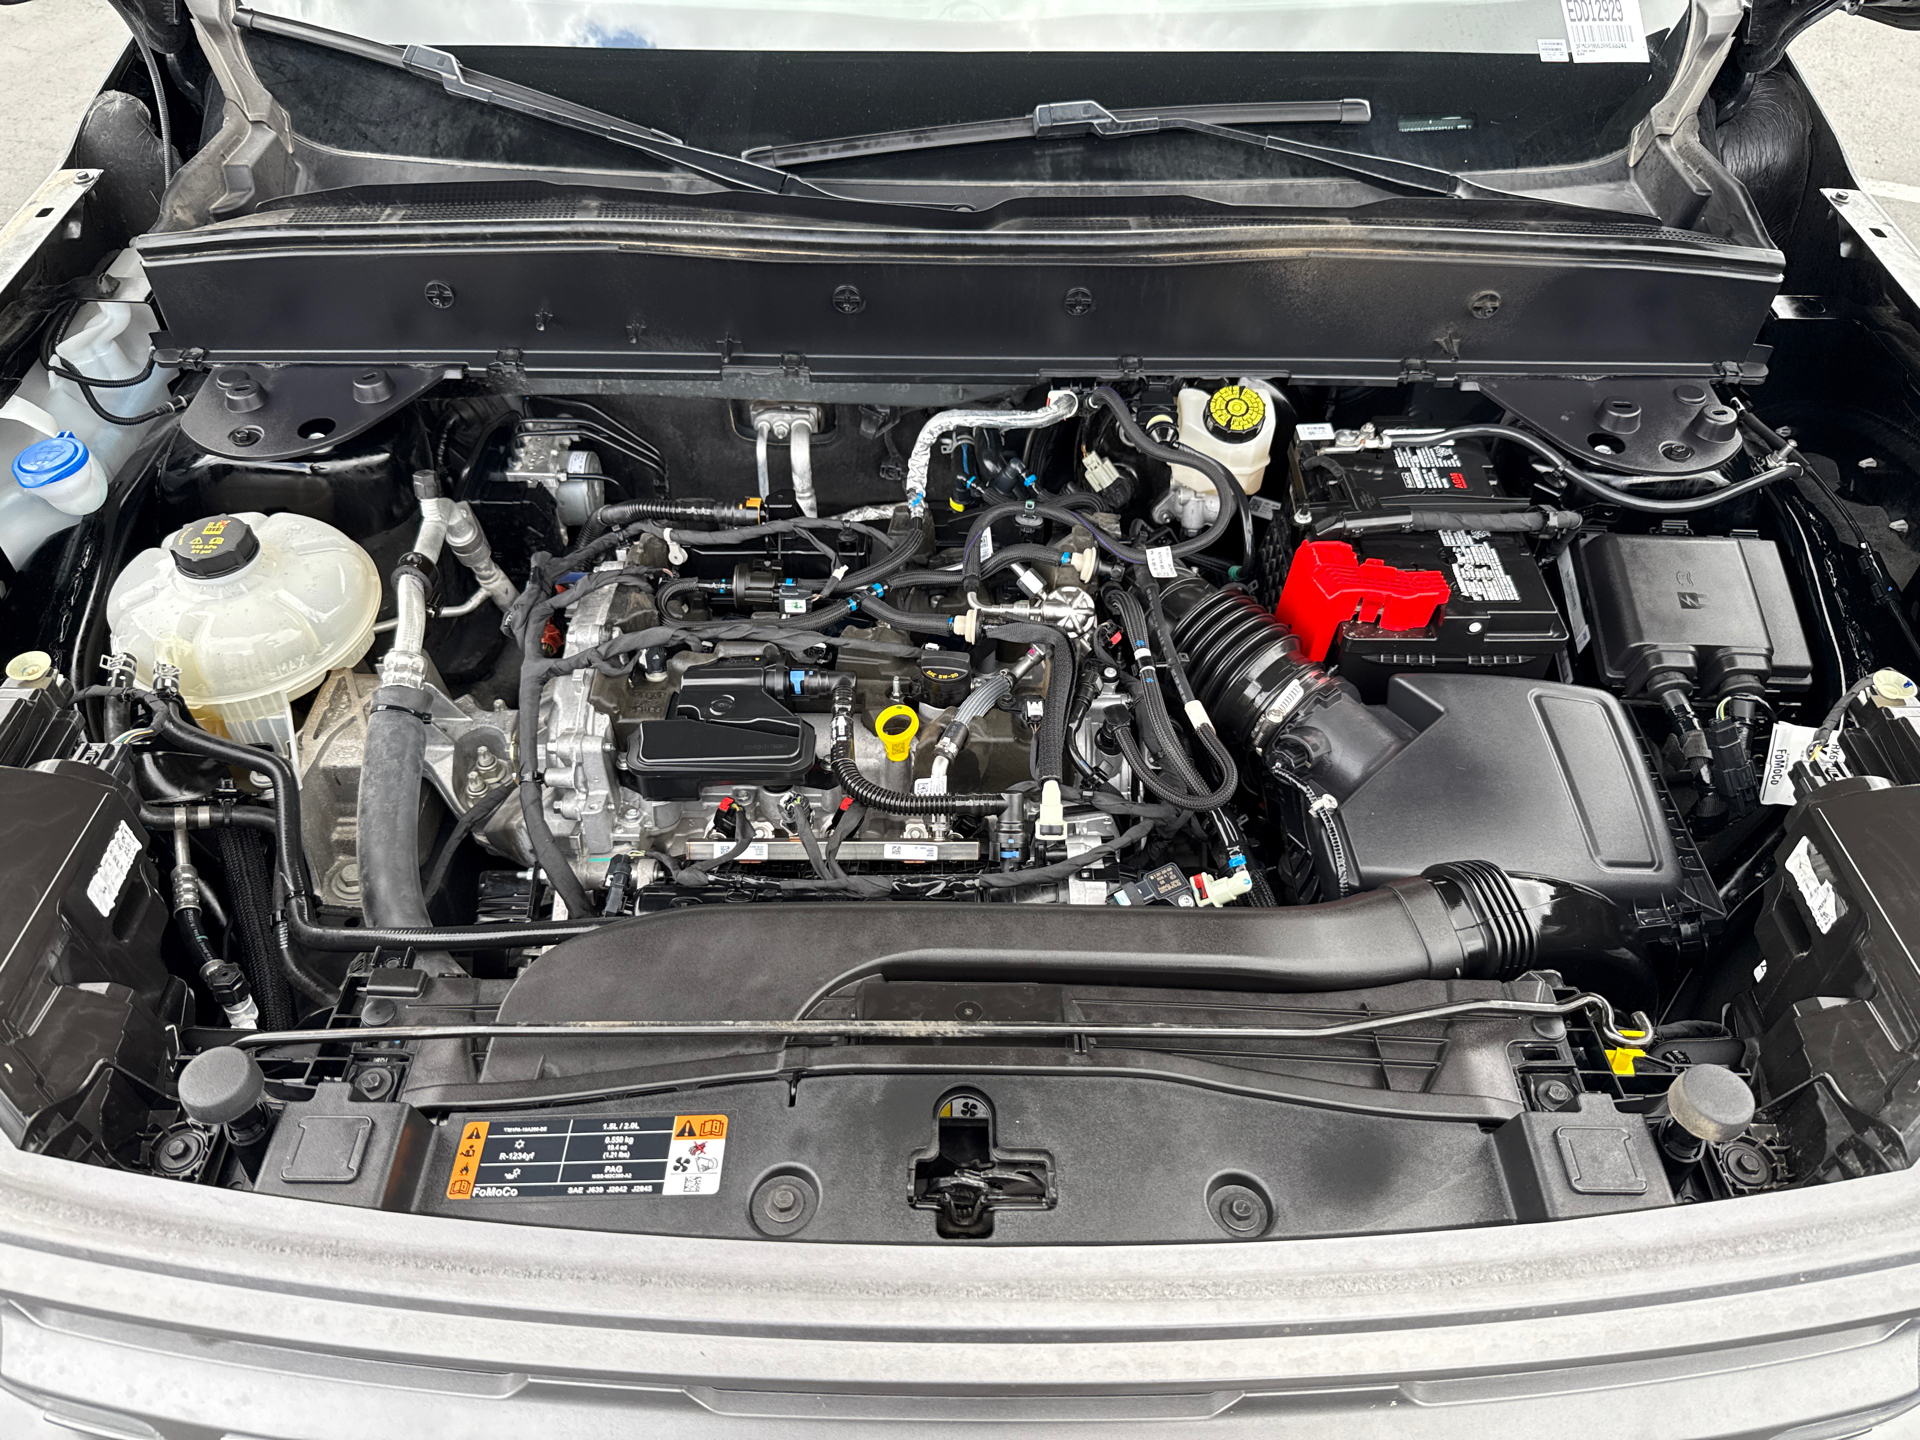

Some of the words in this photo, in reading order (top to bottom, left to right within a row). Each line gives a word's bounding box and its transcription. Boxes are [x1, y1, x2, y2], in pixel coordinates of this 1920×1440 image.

[1566, 0, 1624, 22] EDD12929
[276, 654, 311, 676] MAX
[1770, 748, 1788, 786] FoMoCo
[602, 1122, 619, 1130] 1.5L
[623, 1121, 640, 1130] 2.0L
[604, 1136, 624, 1144] 0.550
[624, 1135, 635, 1145] kg
[498, 1151, 536, 1162] R-1234yf
[604, 1165, 623, 1173] PAG
[472, 1186, 518, 1198] FoMoCo
[567, 1186, 584, 1194] SAE
[585, 1186, 605, 1194] J639
